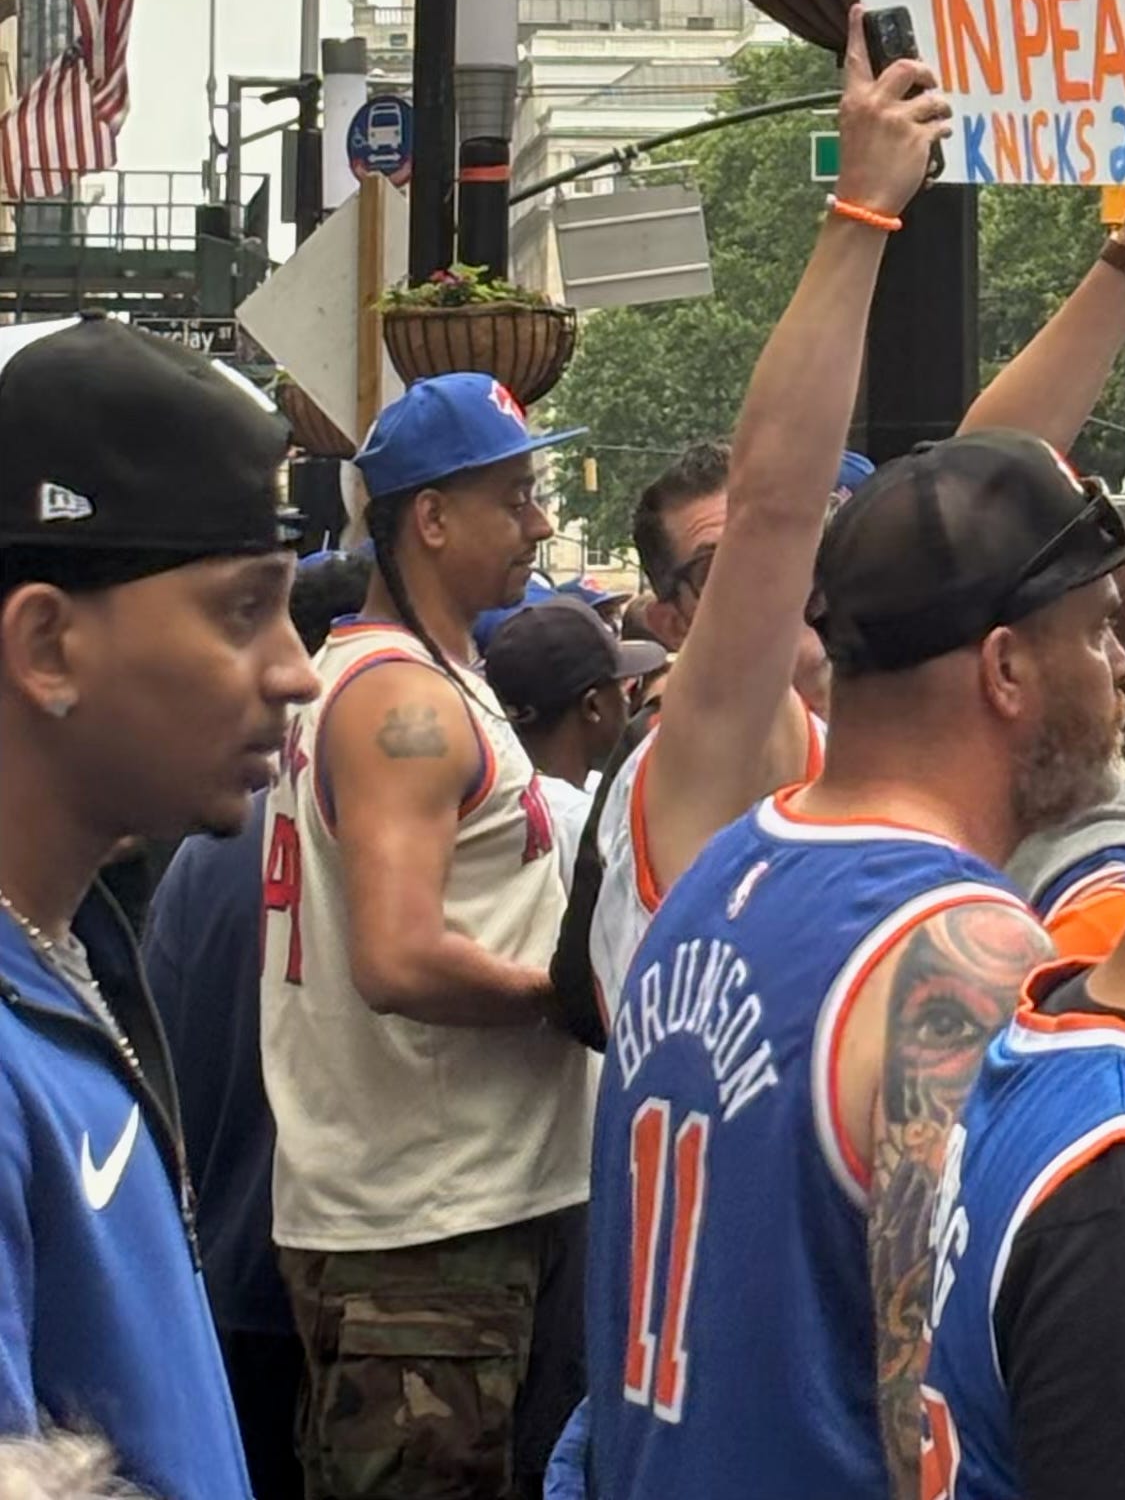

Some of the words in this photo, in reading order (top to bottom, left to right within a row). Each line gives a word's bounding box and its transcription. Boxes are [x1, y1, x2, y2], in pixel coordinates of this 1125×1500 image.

[962, 109, 1096, 183] KNICKS
[615, 938, 778, 1122] BRUNSON
[623, 1097, 711, 1424] 11
